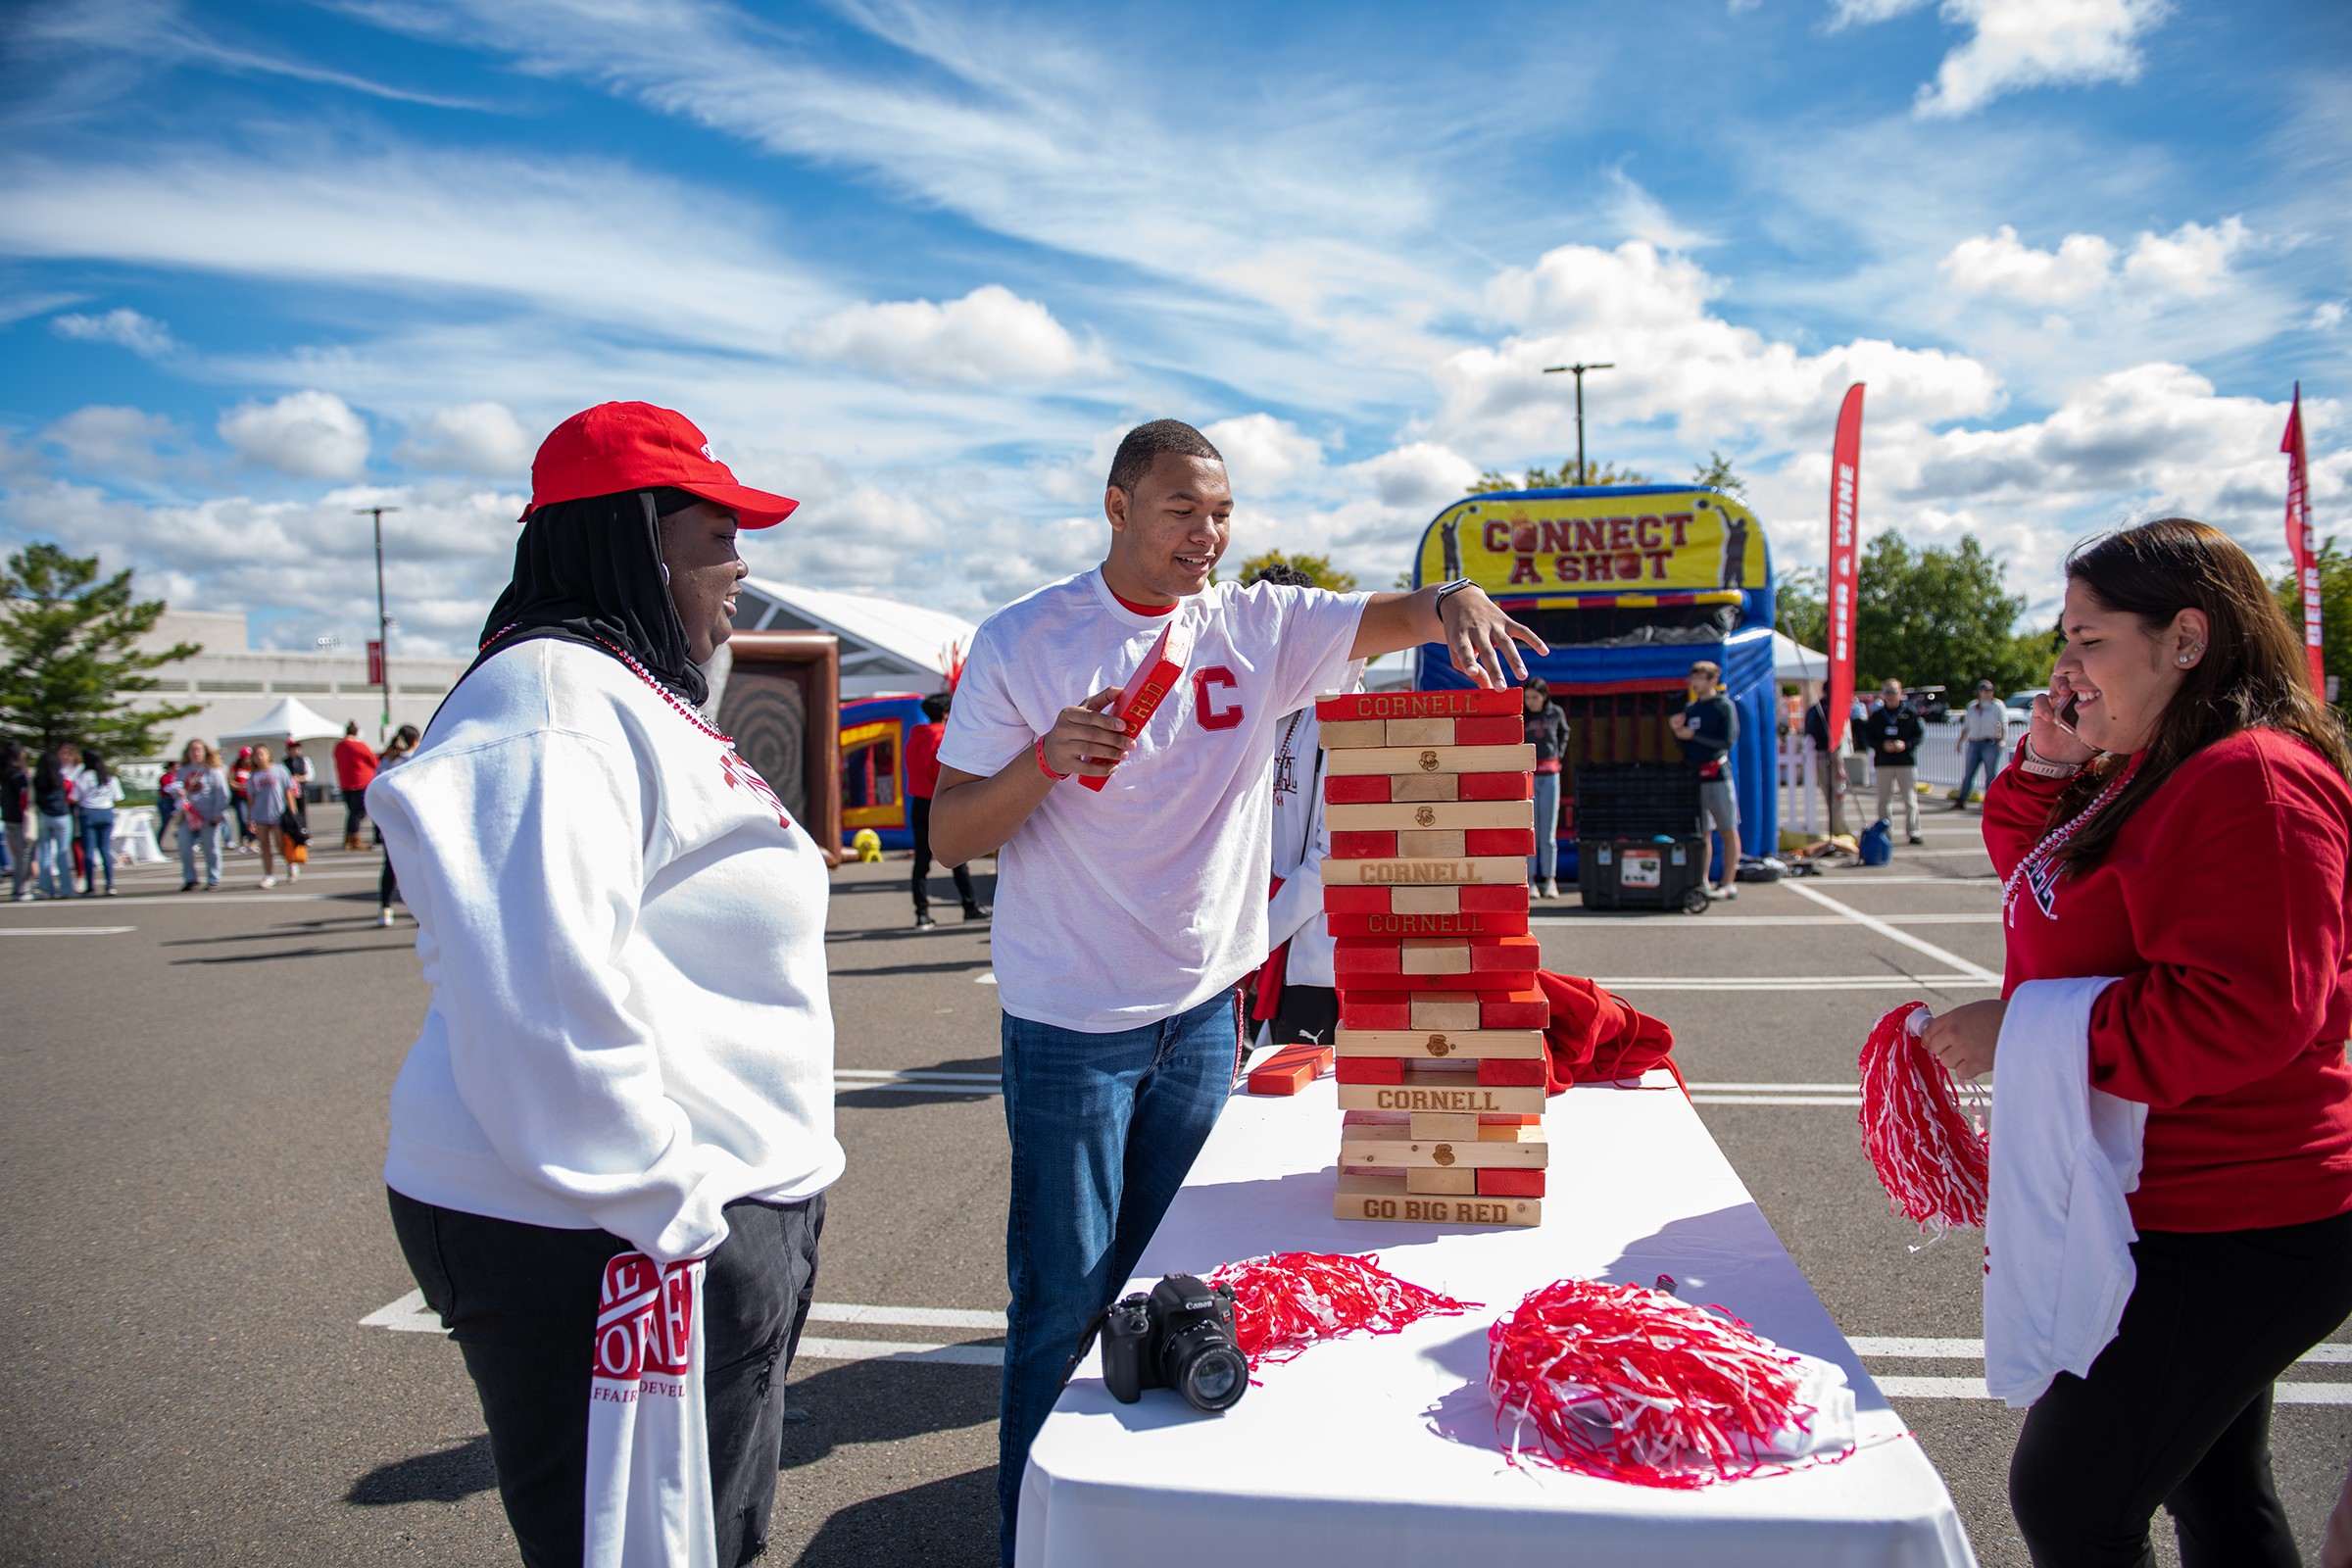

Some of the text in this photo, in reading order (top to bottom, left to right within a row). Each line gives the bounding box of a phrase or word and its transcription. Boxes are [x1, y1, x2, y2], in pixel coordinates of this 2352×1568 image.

[1836, 462, 1854, 547] WINE
[1483, 512, 1694, 554] CONNECT
[1508, 549, 1674, 585] A SHOT
[1835, 585, 1848, 662] BEER
[1129, 682, 1164, 719] RED
[1191, 665, 1245, 732] C
[1357, 695, 1479, 716] CORNELL
[1359, 861, 1483, 883] CORNELL
[1368, 913, 1485, 934] CORNELL
[1378, 1090, 1500, 1111] CORNELL
[1363, 1199, 1508, 1224] GO BIG RED
[1186, 1300, 1213, 1310] Canon
[590, 1387, 637, 1403] FFAIR
